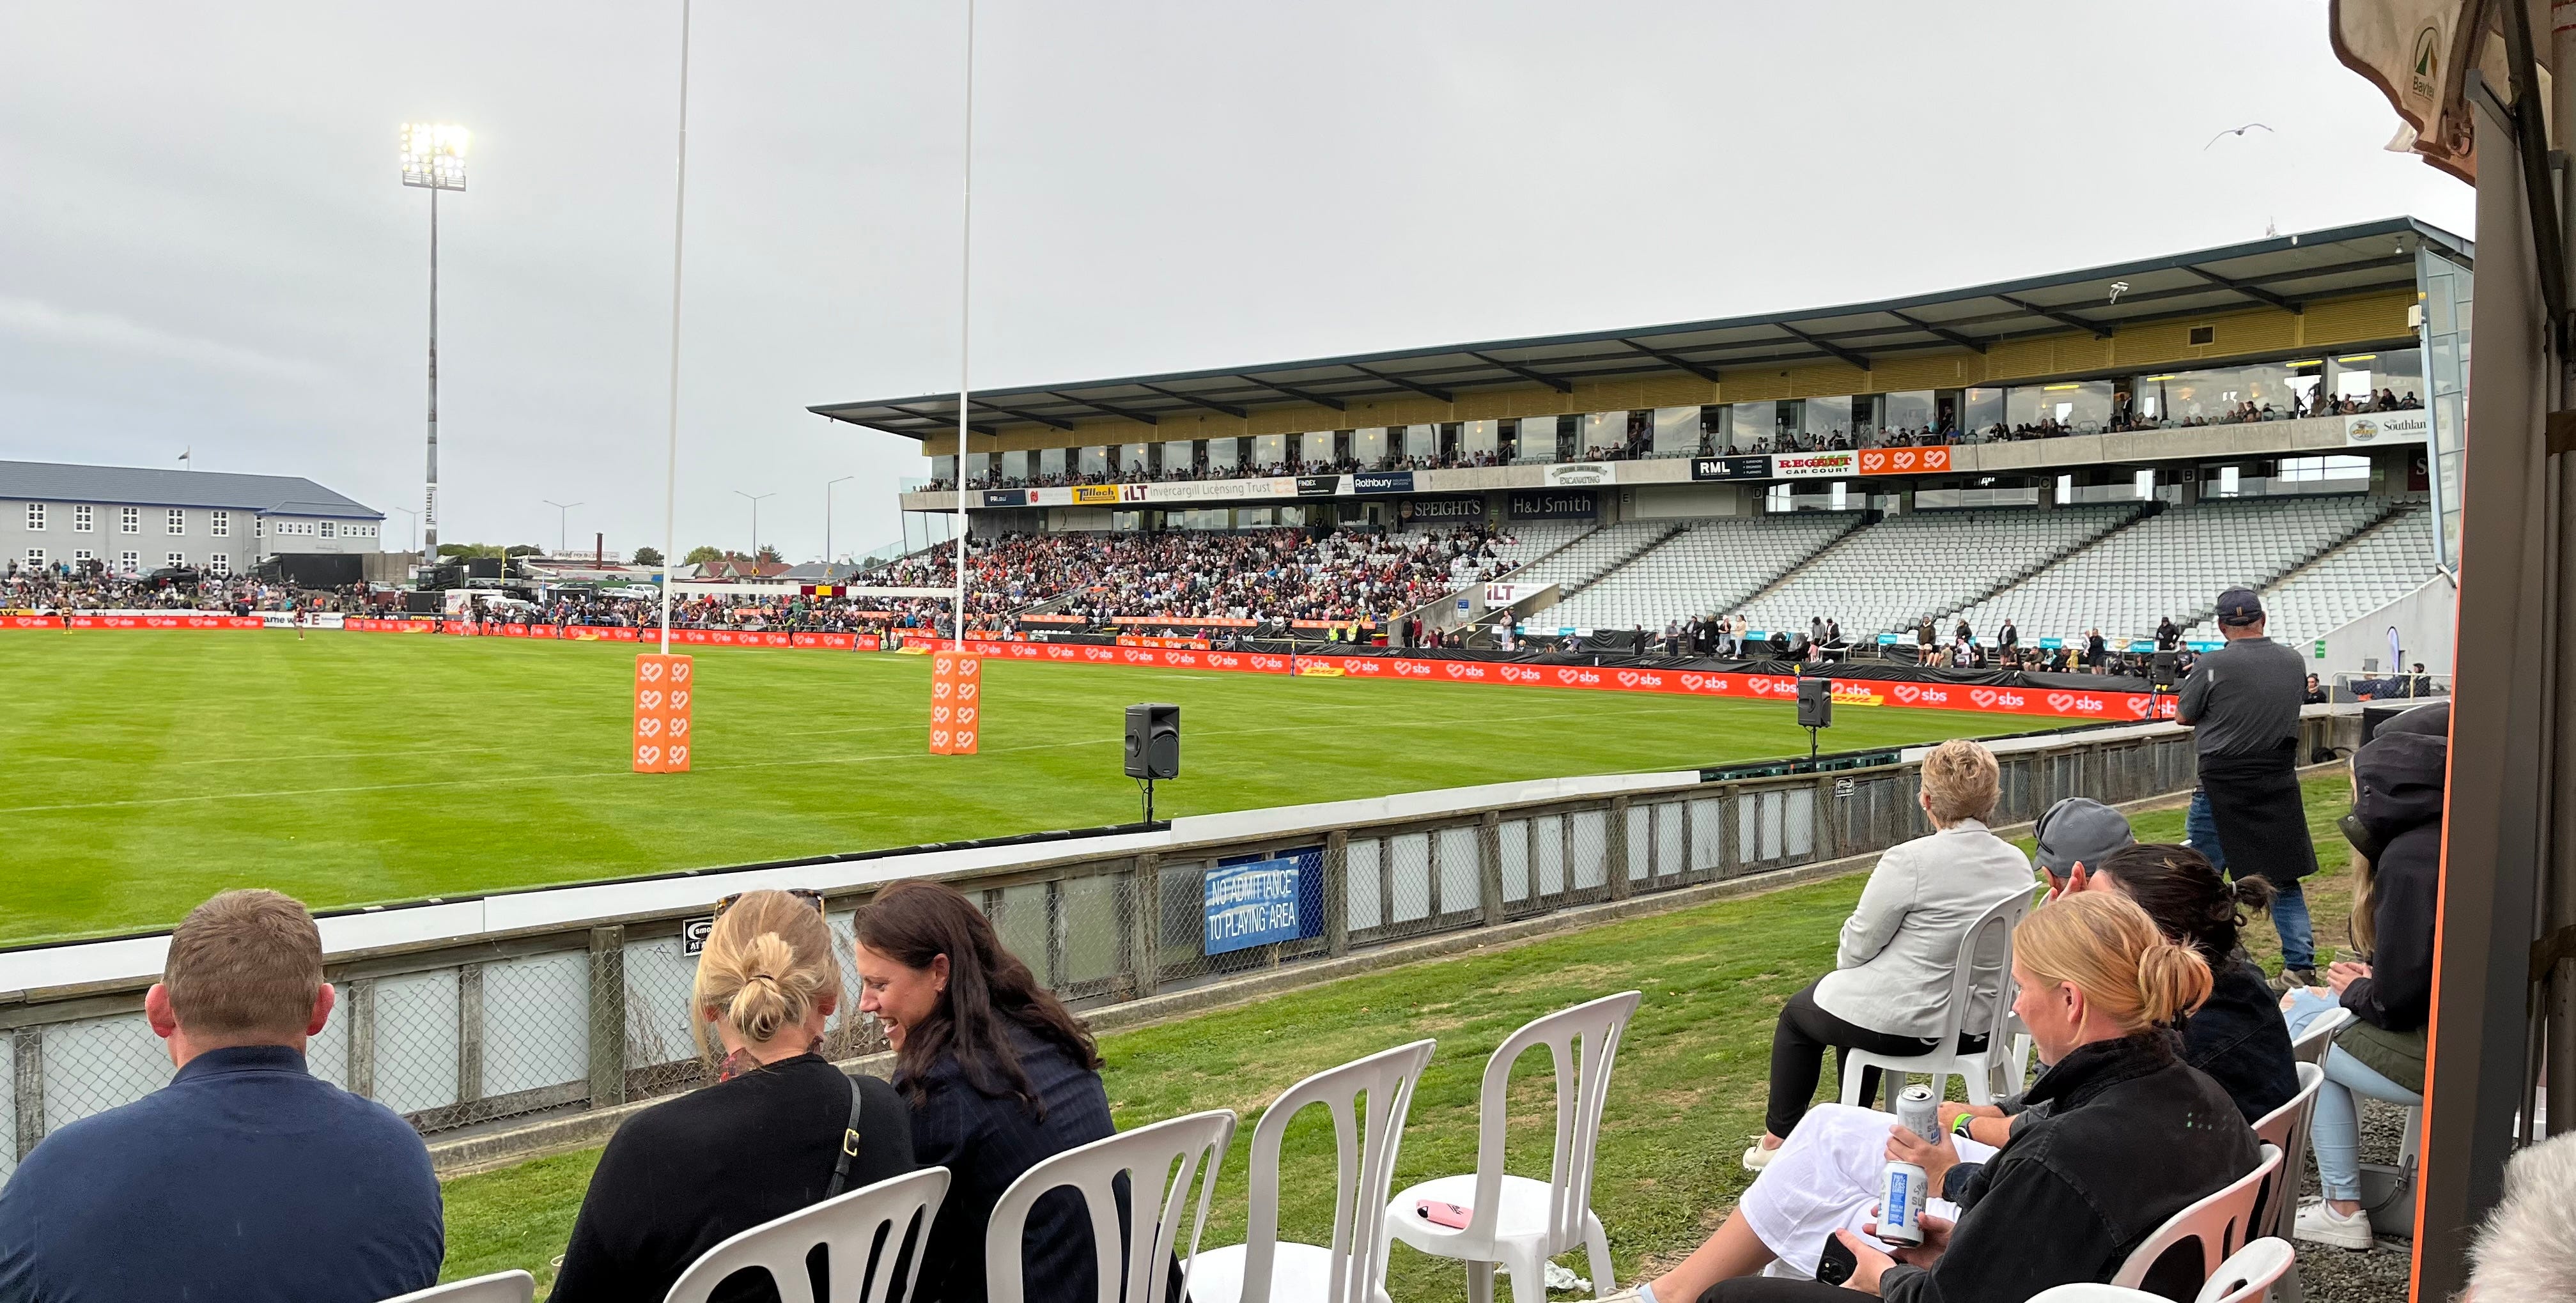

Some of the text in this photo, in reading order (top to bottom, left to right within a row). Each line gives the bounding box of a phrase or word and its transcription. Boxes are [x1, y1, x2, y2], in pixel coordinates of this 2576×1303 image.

[1700, 461, 1730, 473] RML
[2185, 470, 2192, 479] B
[1355, 478, 1392, 488] Rothbury
[2040, 478, 2049, 488] C
[1076, 487, 1113, 501] Tulloch
[1150, 484, 1200, 498] Invercargill
[1203, 483, 1244, 496] Licensing
[1246, 482, 1271, 493] Trust
[1754, 489, 1762, 498] D
[1623, 494, 1629, 502] E
[1415, 499, 1480, 516] SPEIGHT'S
[1514, 497, 1591, 514] H&J Smith
[989, 644, 1001, 654] sbs
[1024, 645, 1037, 655] sbs
[1061, 647, 1074, 657] sbs
[1099, 649, 1113, 658] sbs
[1138, 651, 1153, 661] sbs
[1181, 653, 1195, 663] sbs
[1223, 655, 1238, 666] sbs
[1266, 657, 1283, 668] sbs
[1314, 659, 1330, 668] sbs
[1362, 661, 1379, 672] sbs
[1413, 663, 1431, 674] sbs
[1466, 665, 1484, 677] sbs
[1521, 668, 1540, 680] sbs
[1579, 672, 1599, 684] sbs
[1640, 674, 1662, 686] sbs
[1705, 676, 1727, 690] sbs
[1774, 680, 1797, 693] sbs
[1846, 684, 1871, 695] sbs
[1921, 687, 1947, 702] sbs
[1998, 691, 2024, 706] sbs
[2076, 695, 2103, 711] sbs
[1212, 869, 1292, 906] NO ADMITTANCE
[1208, 902, 1296, 941] TO PLAYING AREA
